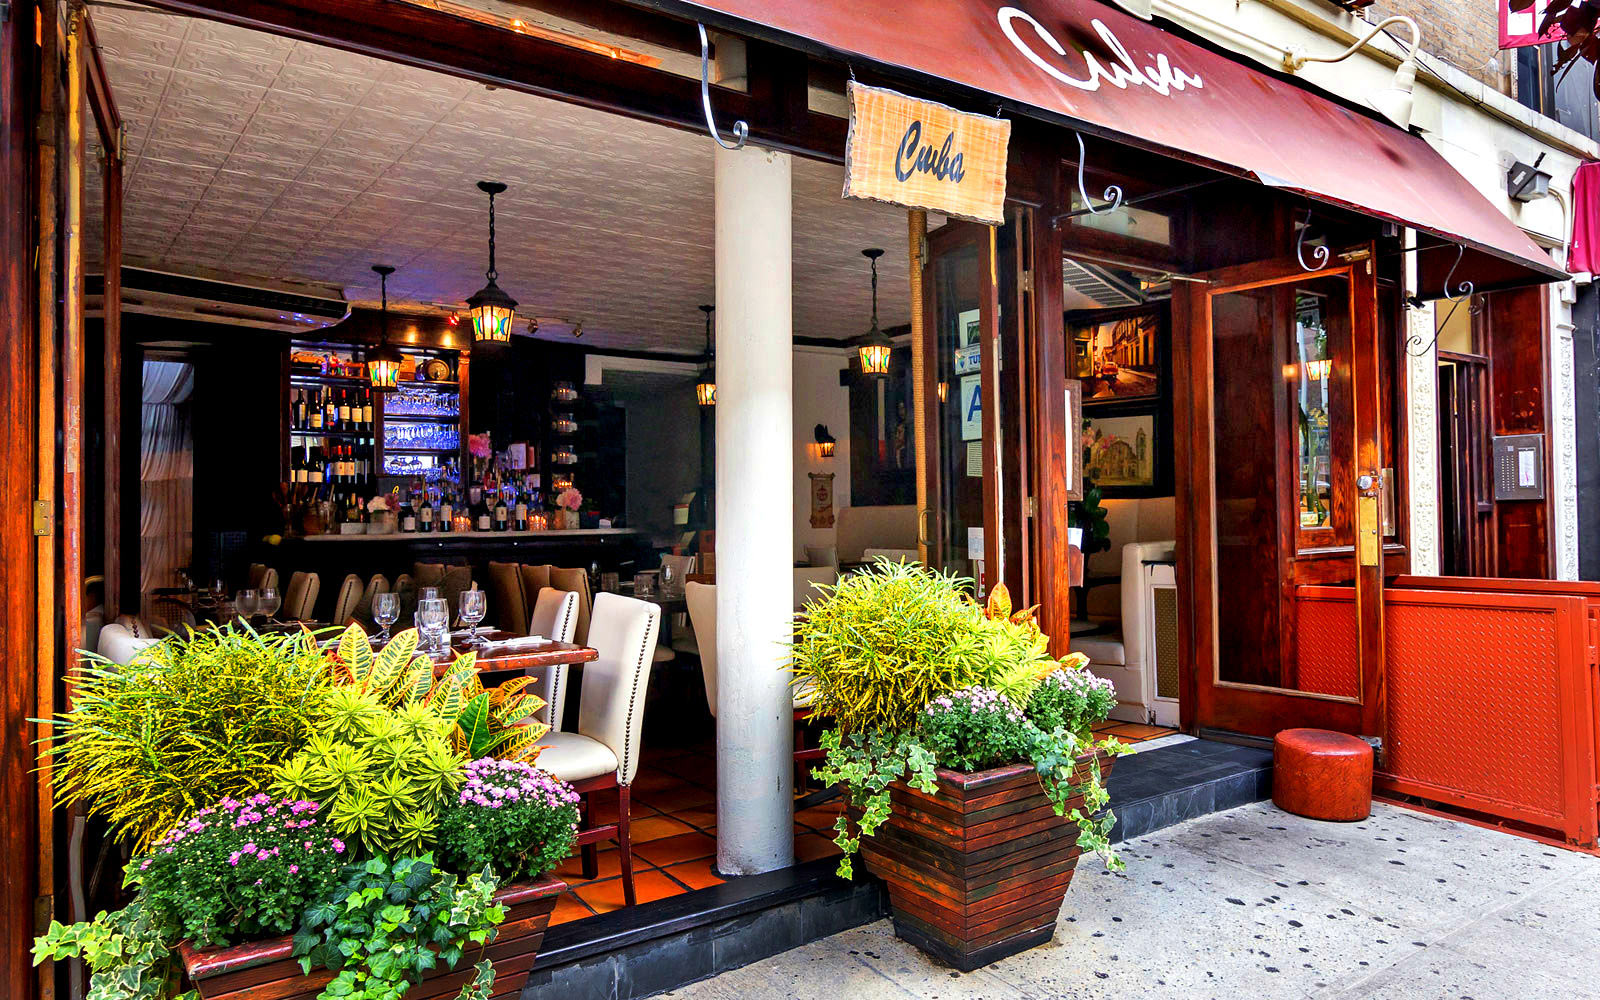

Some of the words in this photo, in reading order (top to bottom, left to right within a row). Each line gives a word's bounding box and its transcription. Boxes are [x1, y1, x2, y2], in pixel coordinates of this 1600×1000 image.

[997, 7, 1203, 96] Cuba
[895, 120, 965, 184] Cuba
[967, 384, 982, 422] A
